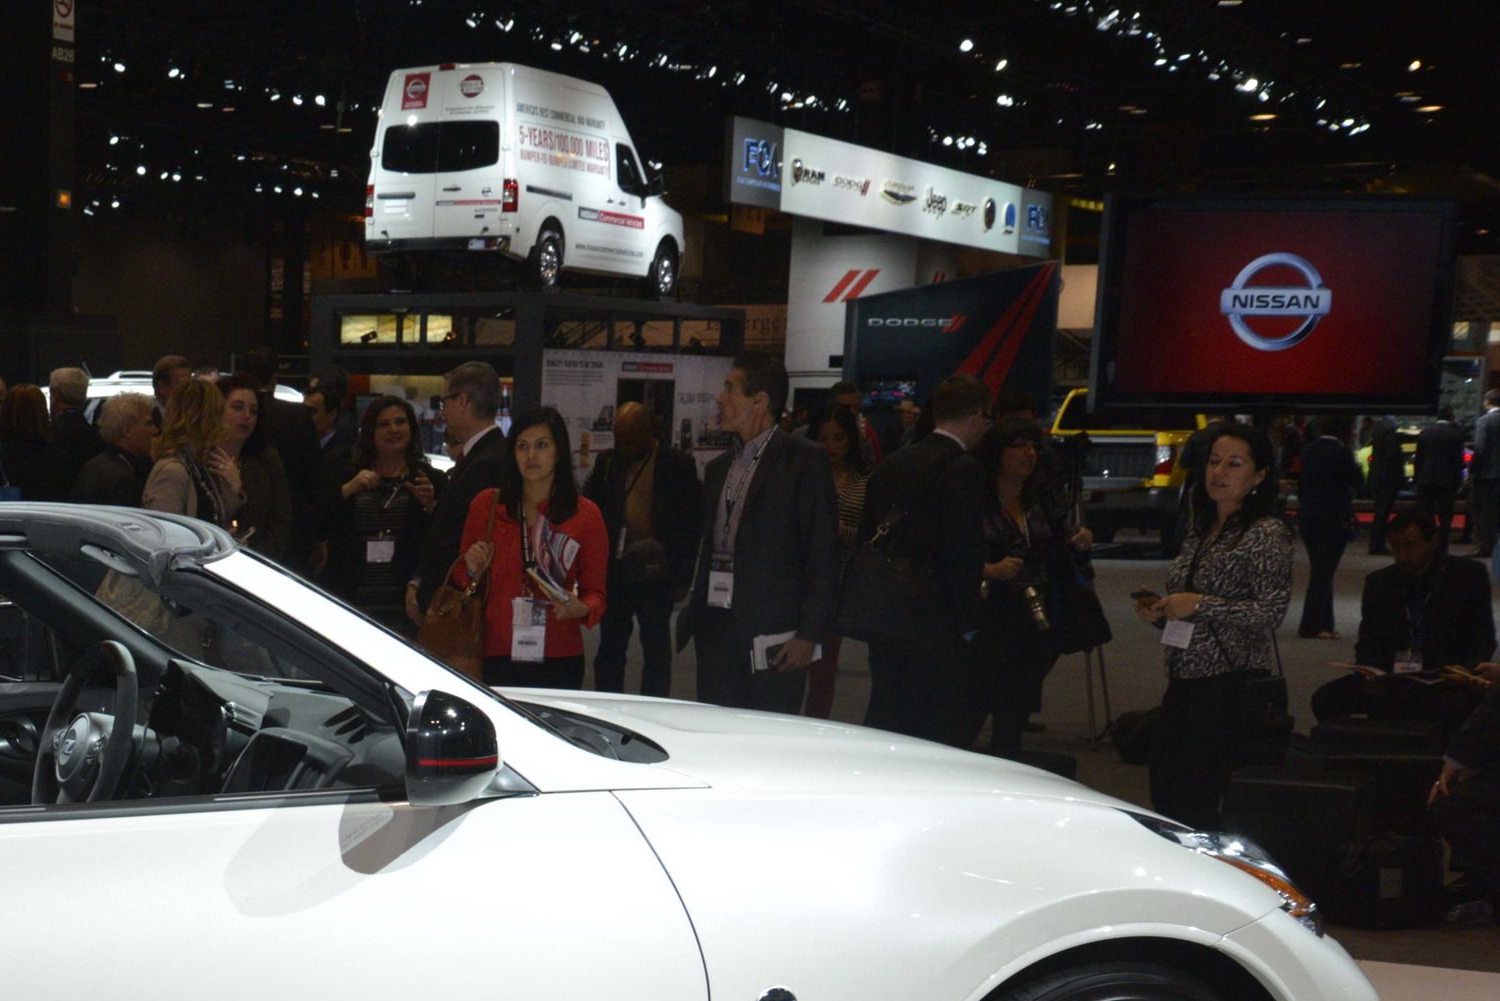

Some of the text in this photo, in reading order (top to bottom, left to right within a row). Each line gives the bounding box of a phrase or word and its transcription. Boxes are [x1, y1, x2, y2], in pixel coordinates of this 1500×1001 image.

[803, 169, 825, 182] RAM
[1232, 294, 1320, 309] NISSAN
[867, 317, 953, 327] DODGE
